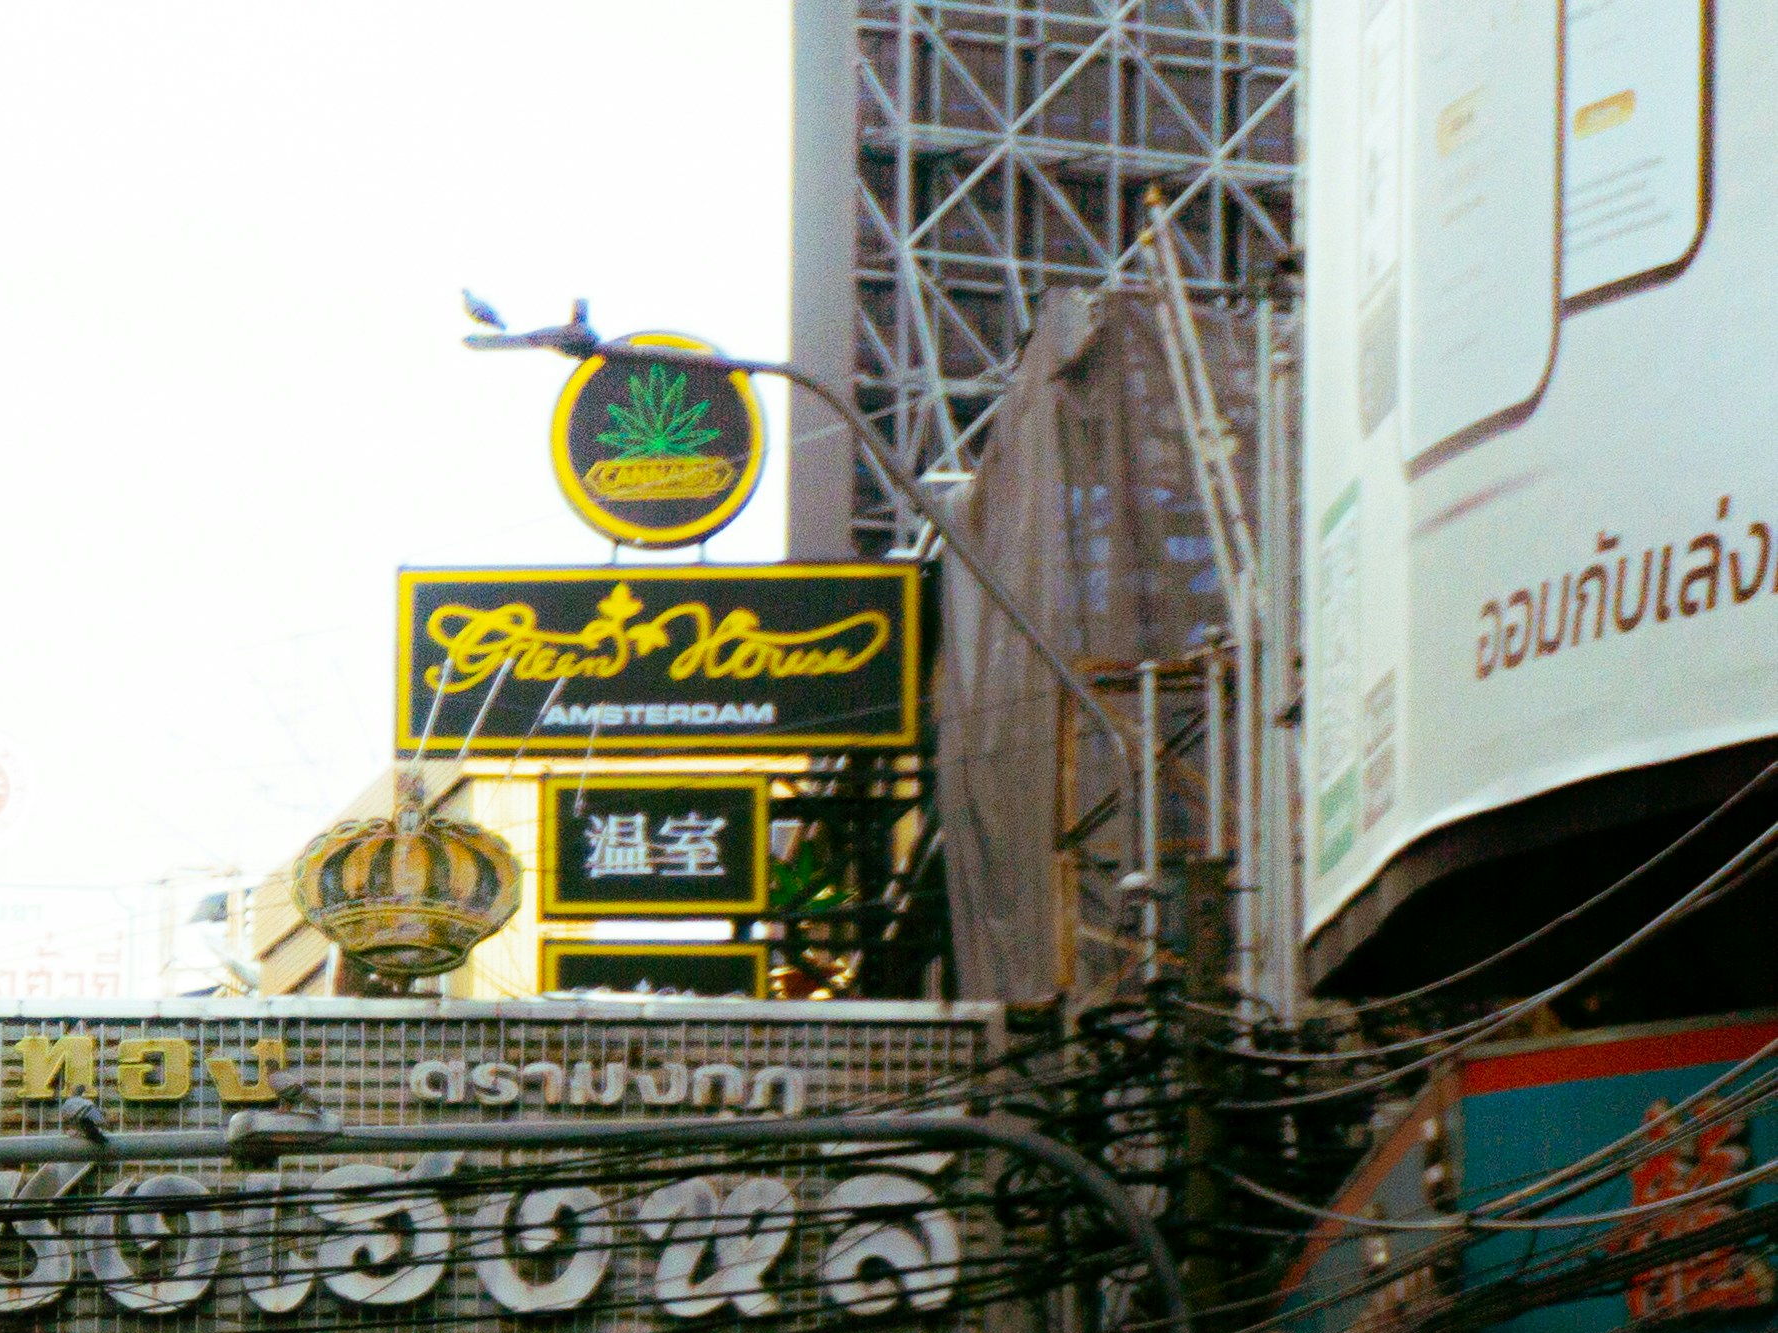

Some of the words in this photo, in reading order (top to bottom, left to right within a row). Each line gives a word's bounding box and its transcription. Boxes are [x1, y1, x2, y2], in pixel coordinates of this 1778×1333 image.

[1476, 495, 1778, 680] ออมกับเล่ง
[426, 600, 627, 694] Green
[669, 600, 890, 682] House
[543, 702, 774, 727] AMSTERDAM
[15, 1035, 287, 1101] ทอง
